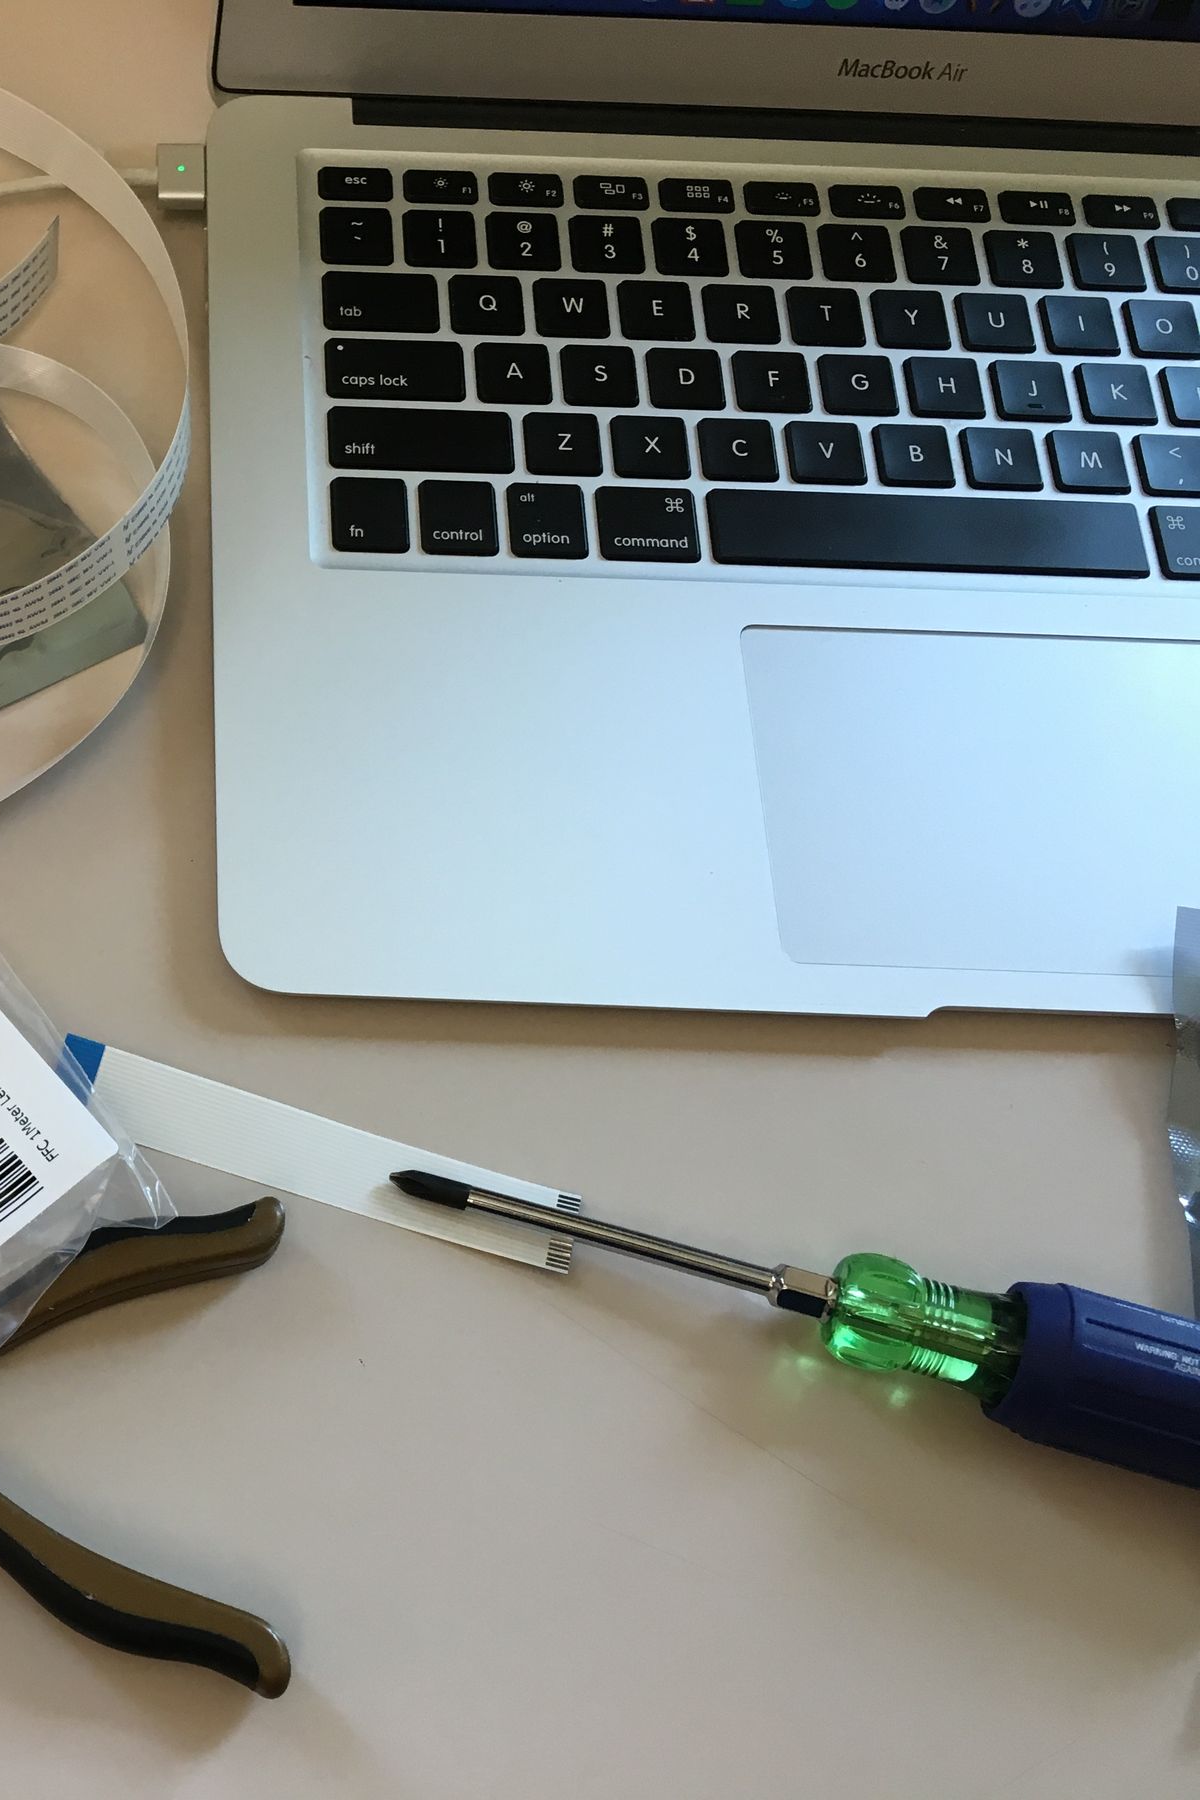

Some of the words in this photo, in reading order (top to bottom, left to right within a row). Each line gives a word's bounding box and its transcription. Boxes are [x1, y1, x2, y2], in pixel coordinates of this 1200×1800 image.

[837, 58, 935, 80] MacBook
[936, 62, 969, 82] Air
[344, 176, 367, 185] esc
[462, 186, 472, 194] F1
[545, 189, 557, 197] F2
[631, 192, 643, 200] F3
[802, 198, 814, 206] F5
[888, 201, 900, 210] F6
[973, 204, 984, 212] F7
[1058, 208, 1070, 216] F8
[1143, 212, 1154, 220] F9
[516, 220, 533, 234] @
[602, 223, 614, 237] #
[685, 225, 697, 241] $
[765, 228, 784, 244] %
[933, 235, 949, 250] &
[437, 239, 445, 254] 1
[520, 241, 533, 257] 2
[604, 244, 617, 259] 3
[687, 247, 700, 262] 4
[772, 250, 784, 265] 5
[854, 253, 867, 268] 6
[937, 256, 949, 271] 7
[1022, 259, 1034, 274] 8
[1104, 262, 1116, 277] 9
[1185, 265, 1199, 281] 0
[479, 294, 498, 311] Q
[562, 296, 584, 314] W
[652, 299, 664, 316] E
[339, 305, 362, 317] tab
[736, 303, 751, 320] R
[819, 305, 832, 321] T
[904, 309, 918, 326] Y
[987, 311, 1005, 328] U
[1078, 315, 1085, 332] I
[1155, 318, 1173, 335] O
[506, 362, 524, 379] A
[594, 365, 608, 382] S
[678, 368, 695, 385] D
[767, 370, 779, 387] F
[341, 375, 376, 388] caps
[379, 374, 408, 387] lock
[851, 373, 869, 391] G
[938, 376, 956, 394] H
[1028, 380, 1038, 397] J
[1110, 383, 1128, 401] K
[344, 442, 376, 455] shift
[557, 433, 573, 451] Z
[644, 436, 662, 454] X
[732, 439, 748, 457] C
[818, 442, 834, 459] V
[908, 445, 924, 462] B
[994, 448, 1013, 466] N
[1080, 451, 1103, 469] M
[519, 492, 535, 502] alt
[348, 524, 364, 538] fn
[432, 529, 483, 541] control
[522, 532, 570, 546] option
[614, 536, 689, 549] command
[37, 1139, 59, 1162] FFC
